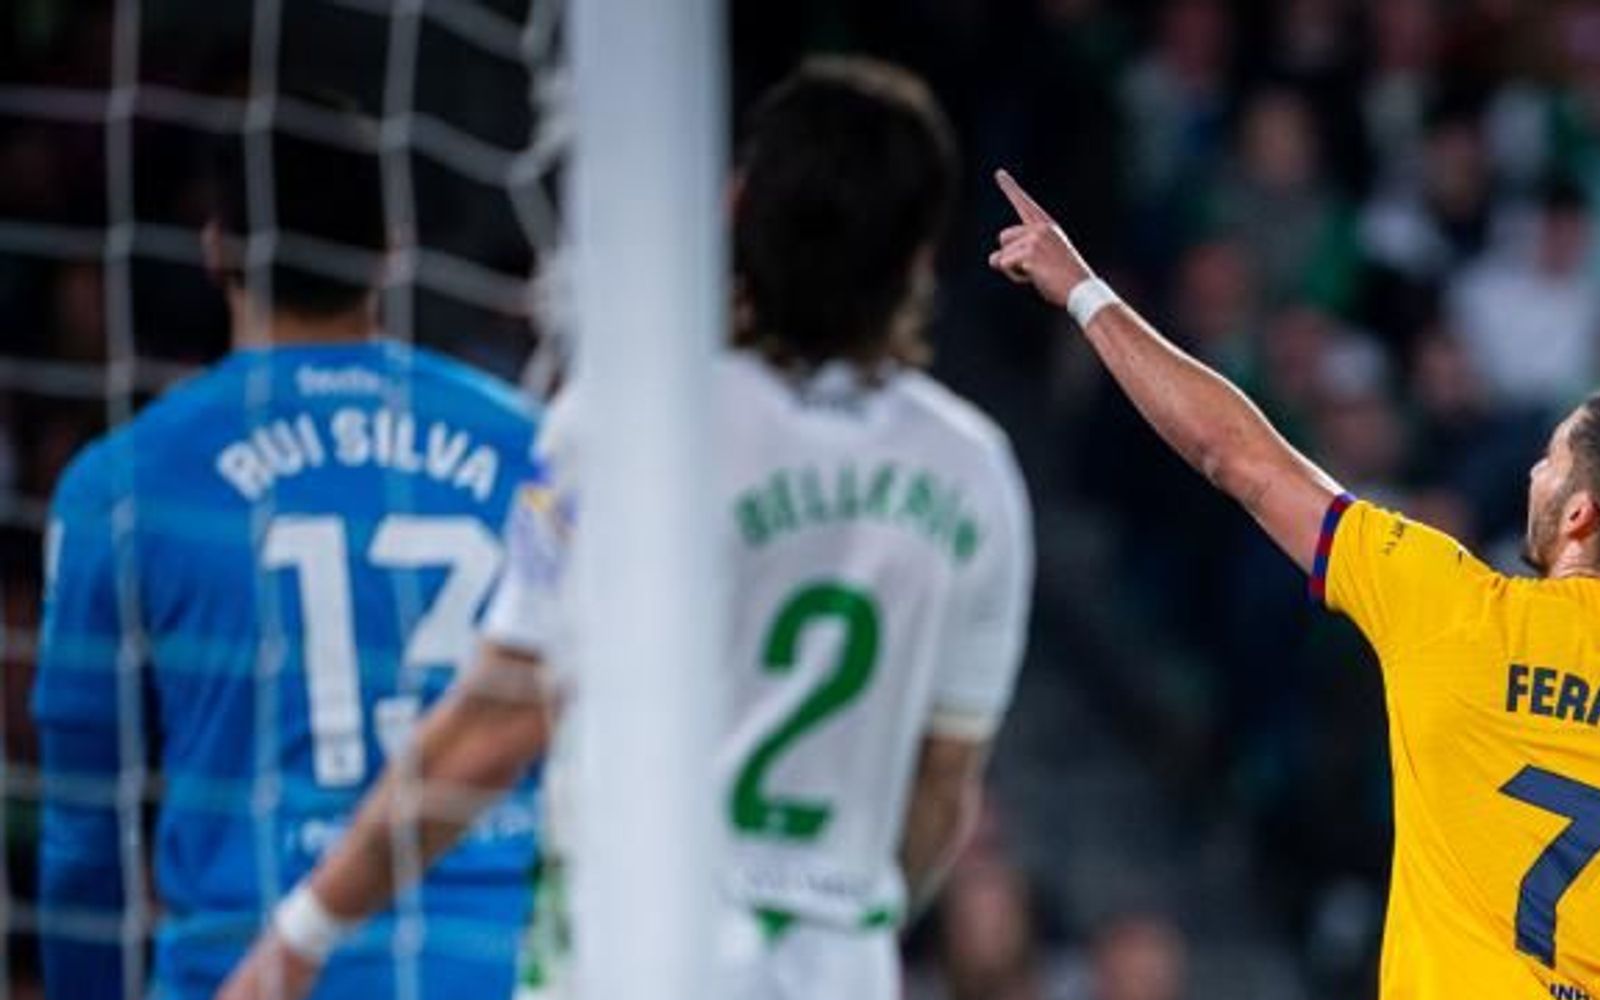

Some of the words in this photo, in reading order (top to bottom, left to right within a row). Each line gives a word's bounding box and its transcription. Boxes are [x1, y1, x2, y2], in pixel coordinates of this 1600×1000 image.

[216, 414, 323, 500] RUI
[330, 408, 501, 498] SILVA
[728, 575, 881, 840] 2
